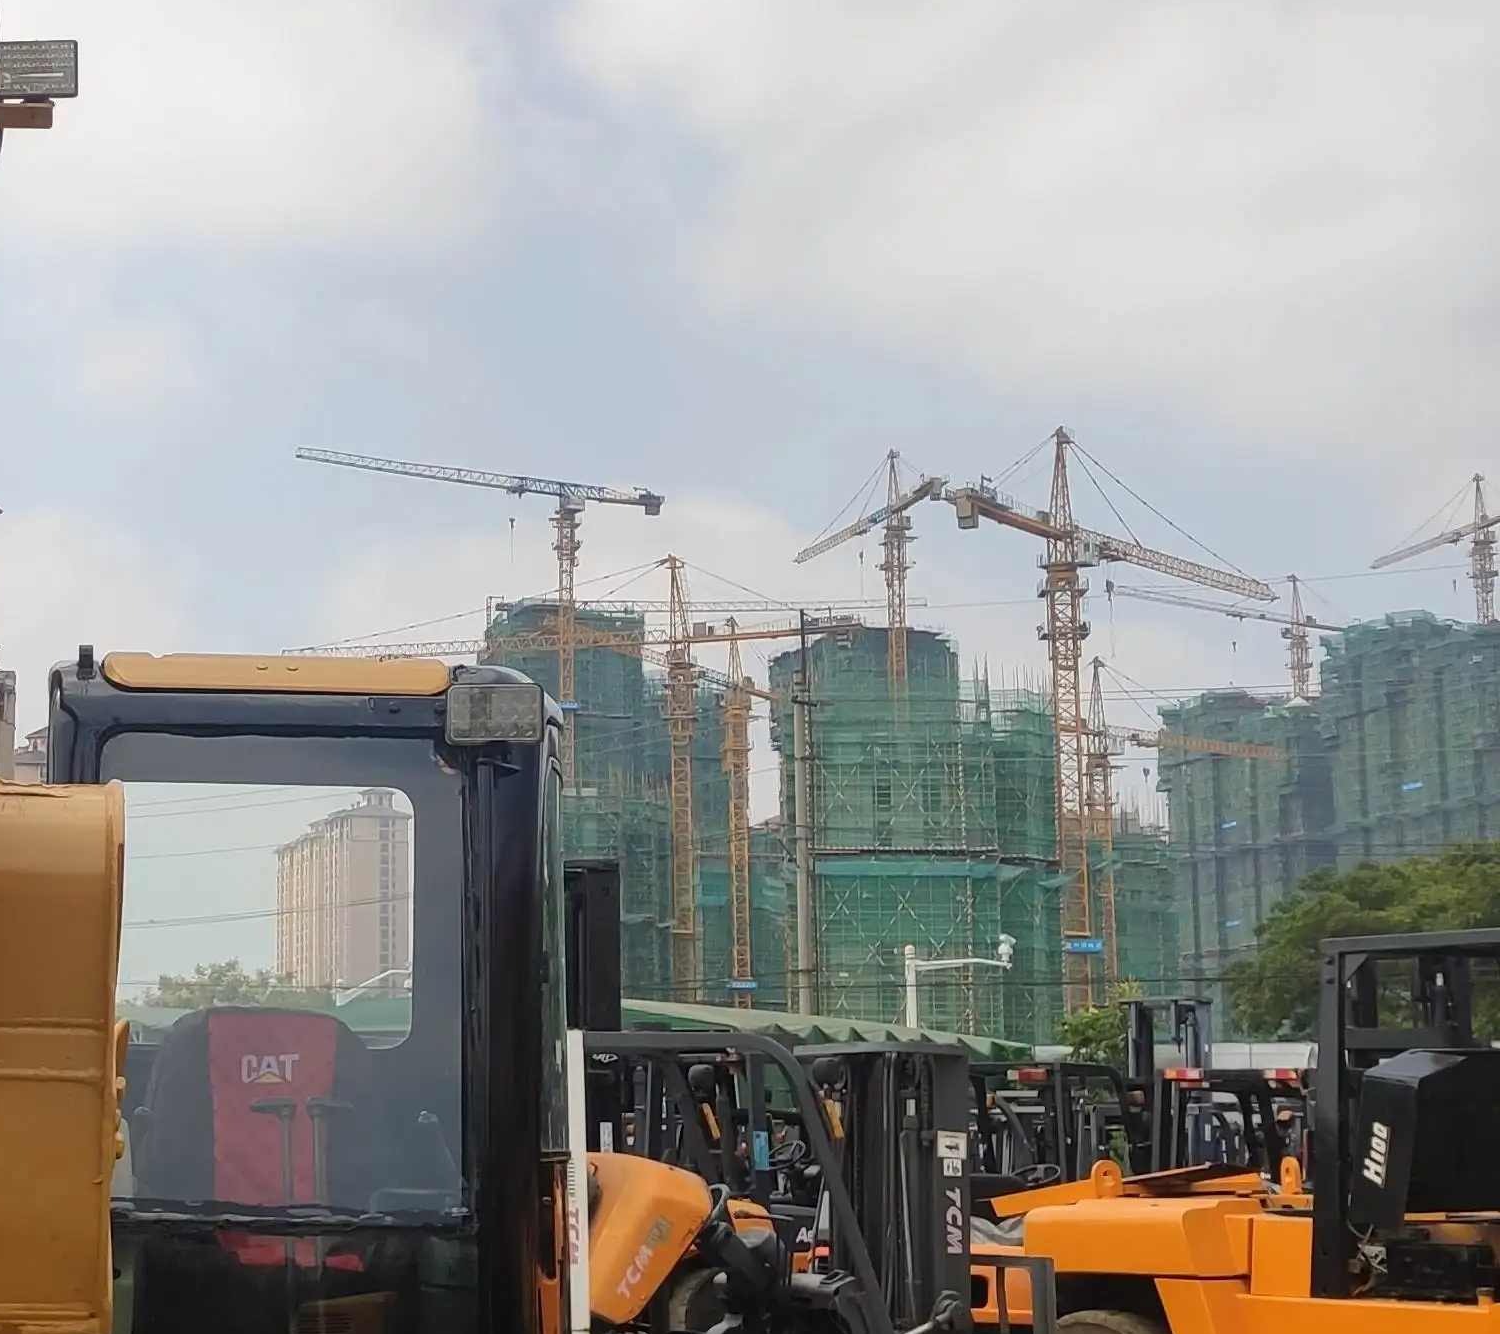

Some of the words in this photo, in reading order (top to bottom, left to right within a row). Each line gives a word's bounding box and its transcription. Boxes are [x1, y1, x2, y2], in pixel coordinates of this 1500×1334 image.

[241, 1053, 300, 1083] CAT
[1363, 1121, 1389, 1186] H100
[568, 1207, 580, 1265] TCM
[945, 1186, 963, 1255] TCM
[616, 1245, 653, 1299] TCM
